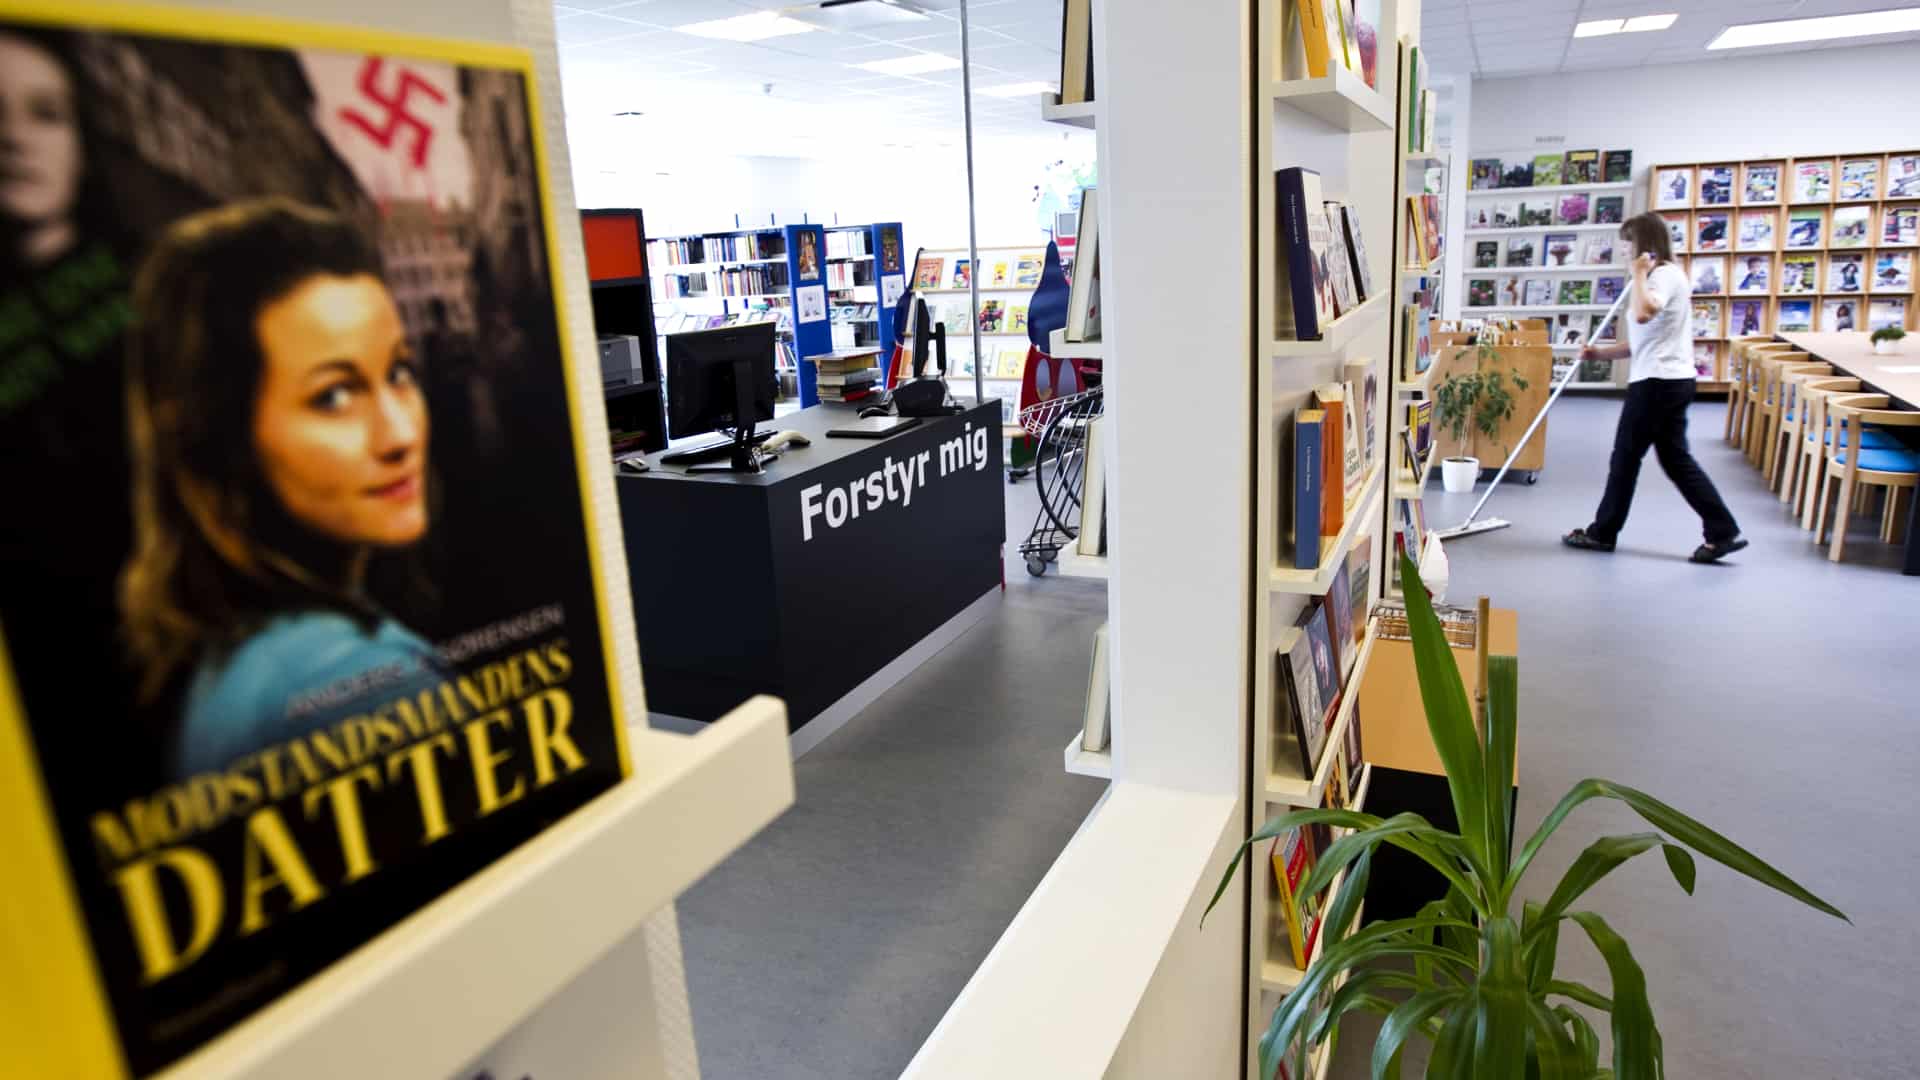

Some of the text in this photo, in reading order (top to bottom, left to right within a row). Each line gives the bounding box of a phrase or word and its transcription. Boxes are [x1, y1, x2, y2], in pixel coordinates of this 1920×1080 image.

[800, 422, 988, 542] Forstyr mig
[91, 640, 573, 862] MODSTANDSMANDENS
[114, 687, 589, 985] DATTER
